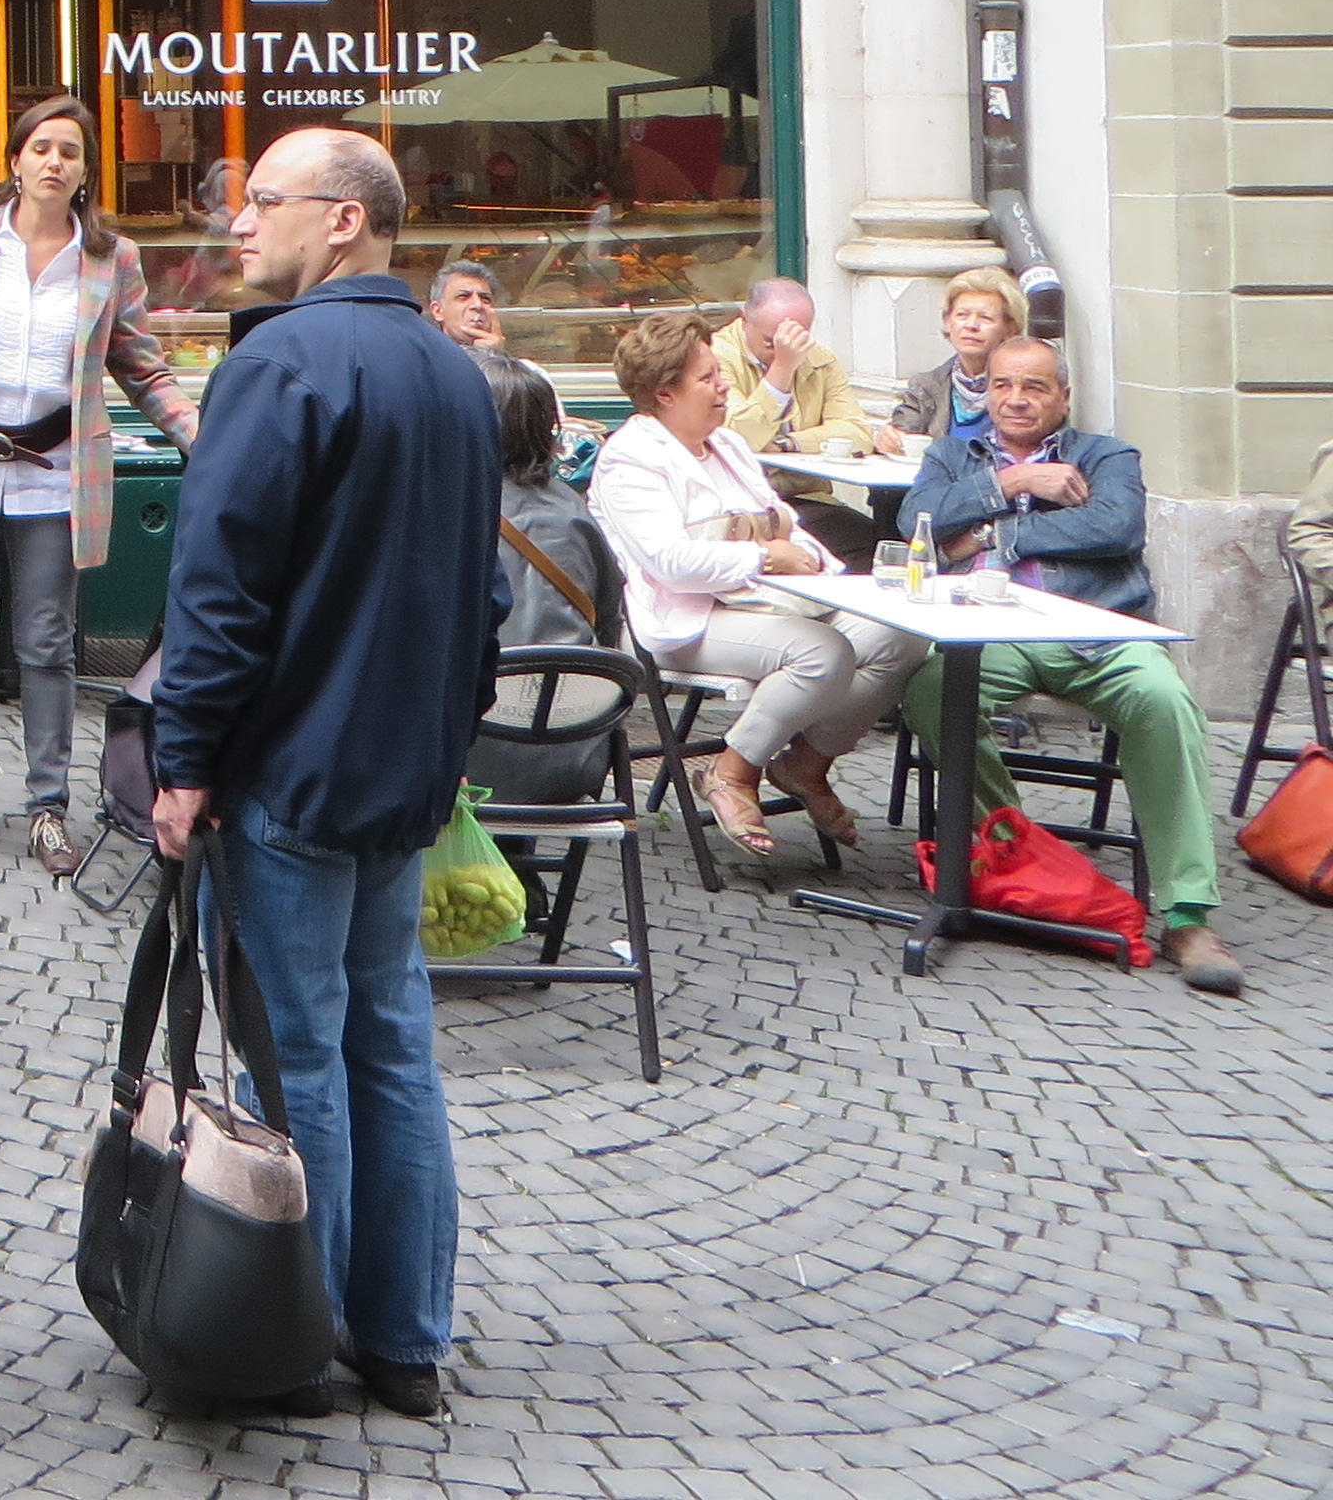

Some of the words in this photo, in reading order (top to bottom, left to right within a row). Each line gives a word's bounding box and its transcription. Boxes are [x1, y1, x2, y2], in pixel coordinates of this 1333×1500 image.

[102, 31, 483, 75] MOUTARLIER
[143, 89, 246, 106] LAUSANNE
[262, 88, 366, 106] CHEXBRES
[379, 88, 442, 106] LUTRY
